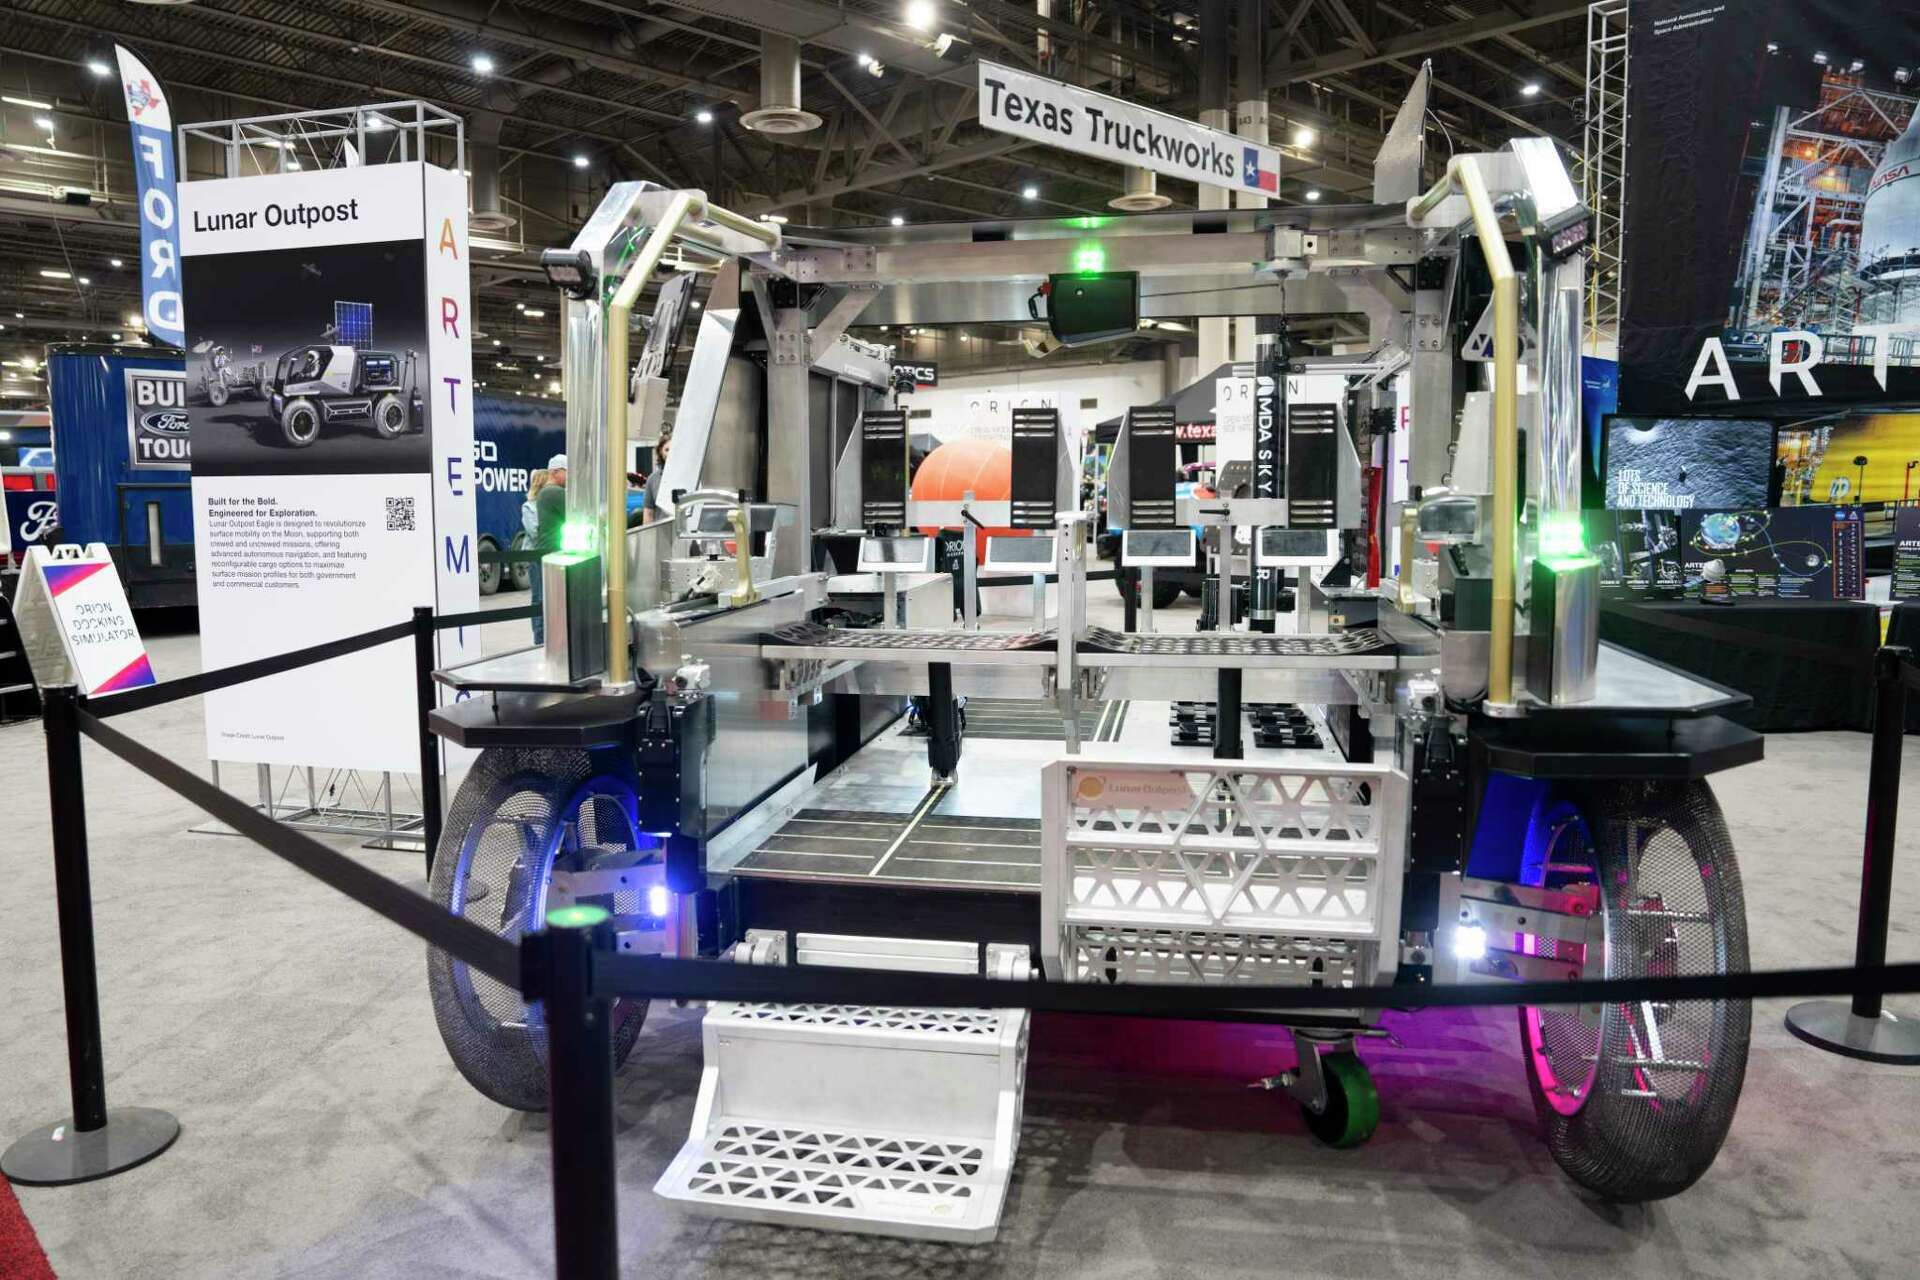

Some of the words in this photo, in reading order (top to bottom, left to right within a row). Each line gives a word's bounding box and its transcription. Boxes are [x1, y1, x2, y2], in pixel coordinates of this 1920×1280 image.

[984, 78, 1074, 136] Texas
[1085, 106, 1234, 178] Truckworks
[193, 211, 258, 233] Lunar
[264, 198, 359, 229] Outpost
[136, 380, 185, 407] BUI
[1257, 397, 1273, 443] MDA
[139, 437, 192, 459] TOU
[438, 217, 472, 703] ARTEMI
[1618, 469, 1641, 482] LOTS
[1618, 482, 1629, 495] OF
[1631, 481, 1669, 495] SCIENCE
[208, 497, 227, 506] Built
[228, 497, 240, 506] for
[242, 497, 255, 506] the
[257, 497, 278, 506] Bold.
[208, 509, 254, 519] Engineered
[255, 508, 267, 518] for
[269, 508, 318, 519] Exploration.
[75, 601, 113, 615] ORION
[72, 616, 125, 630] DOCKING
[71, 628, 136, 646] SIMULATOR
